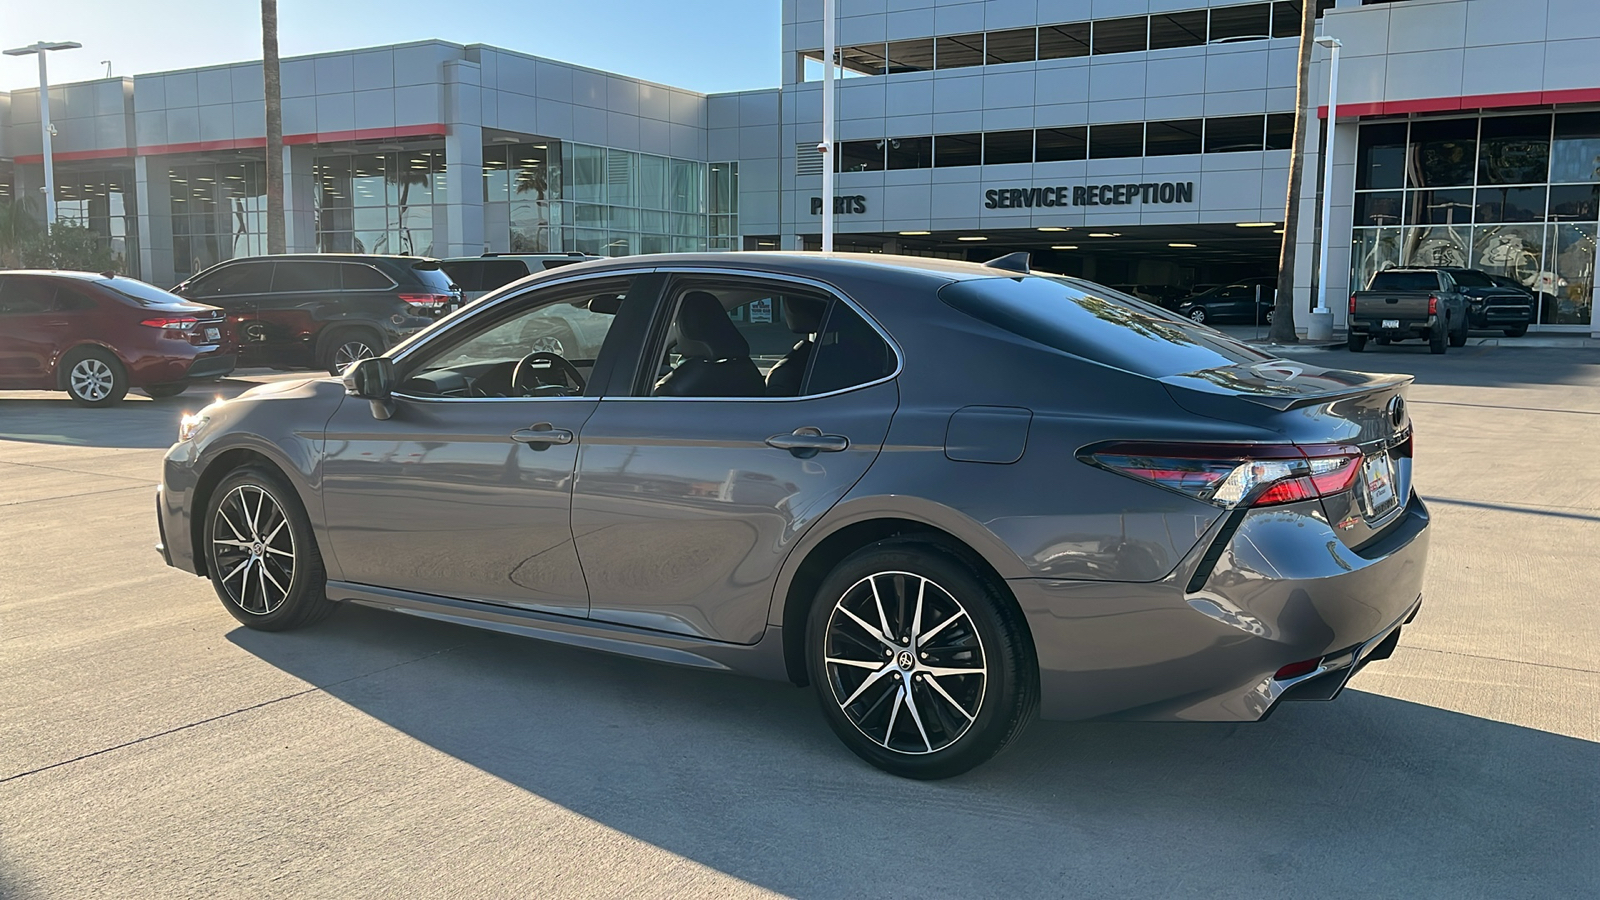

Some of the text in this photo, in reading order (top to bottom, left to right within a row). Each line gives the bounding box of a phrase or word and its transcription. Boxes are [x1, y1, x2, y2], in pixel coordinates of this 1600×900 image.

[810, 194, 867, 215] PRTS
[985, 182, 1194, 209] SERVICE RECEPTION
